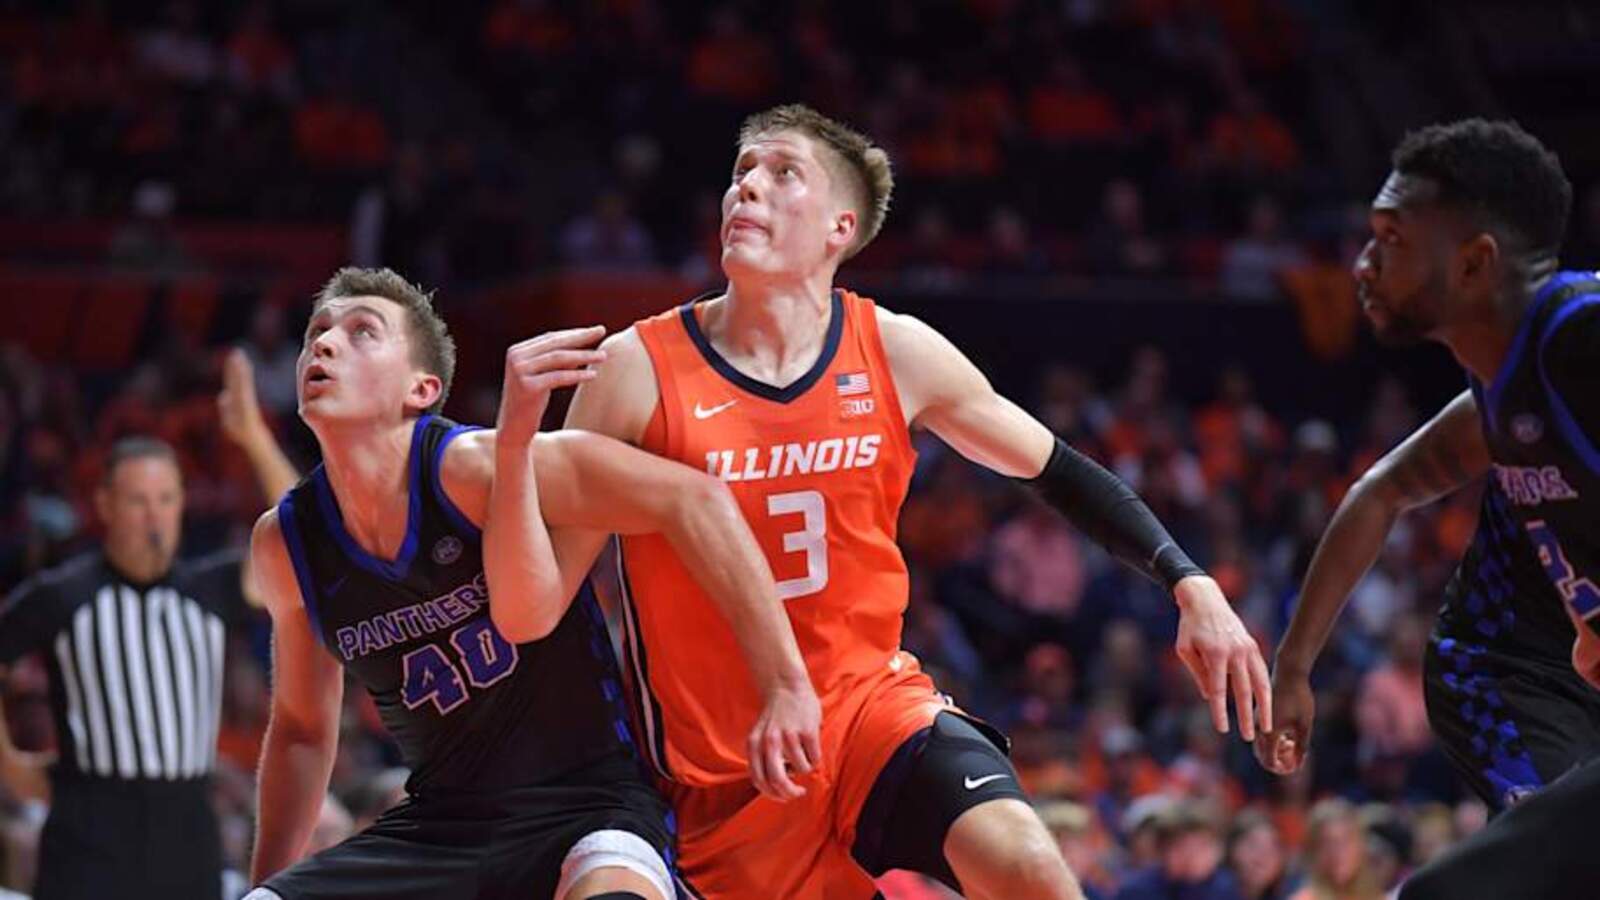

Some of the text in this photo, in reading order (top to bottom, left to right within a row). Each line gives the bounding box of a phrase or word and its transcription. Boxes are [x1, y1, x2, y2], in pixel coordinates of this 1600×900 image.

[705, 433, 882, 483] ILLINOIS
[767, 489, 829, 600] 3
[401, 618, 519, 716] 40
